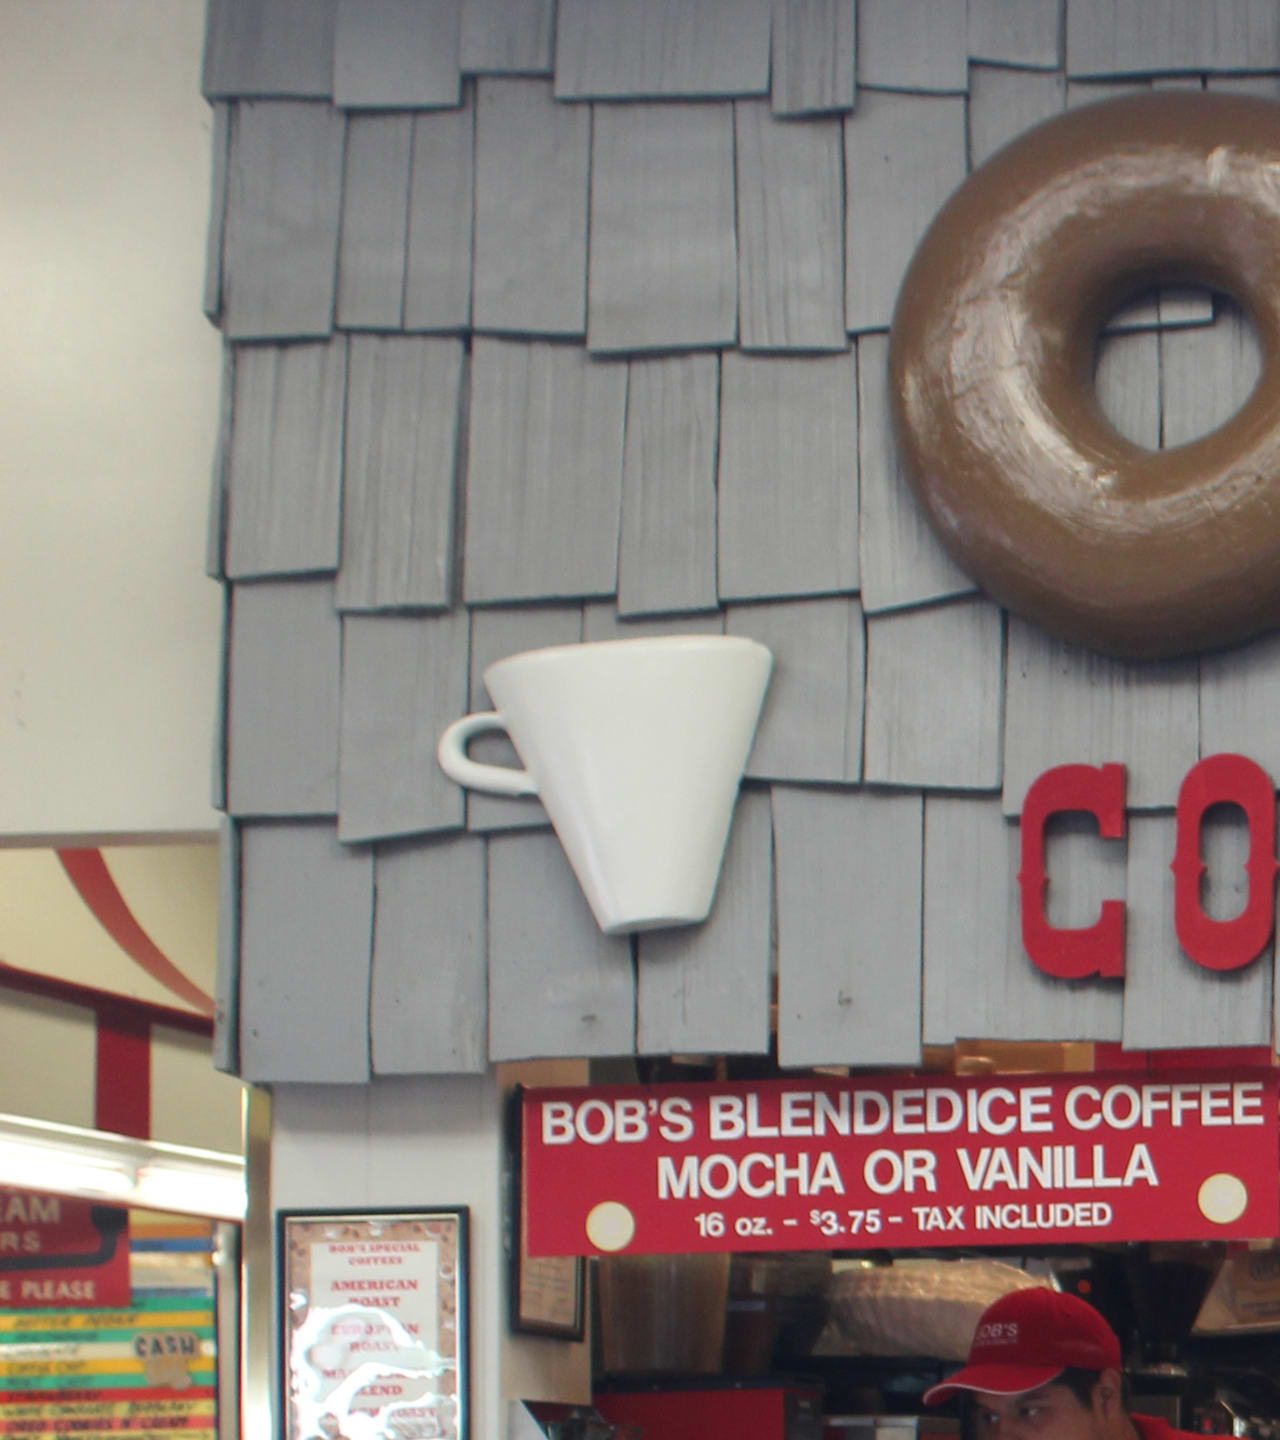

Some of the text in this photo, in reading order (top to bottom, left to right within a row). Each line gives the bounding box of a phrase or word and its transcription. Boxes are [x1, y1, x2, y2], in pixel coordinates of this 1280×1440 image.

[541, 1097, 694, 1146] BOB'S
[1064, 1082, 1265, 1132] COFFEE
[657, 1143, 1158, 1200] MOCHA OR VANILLA
[694, 1202, 1113, 1237] 16 oz. $3.75 TAX INCLUDED
[22, 1280, 95, 1300] PLEASE
[331, 1280, 418, 1291] AMERICAN
[135, 1334, 195, 1358] CASH
